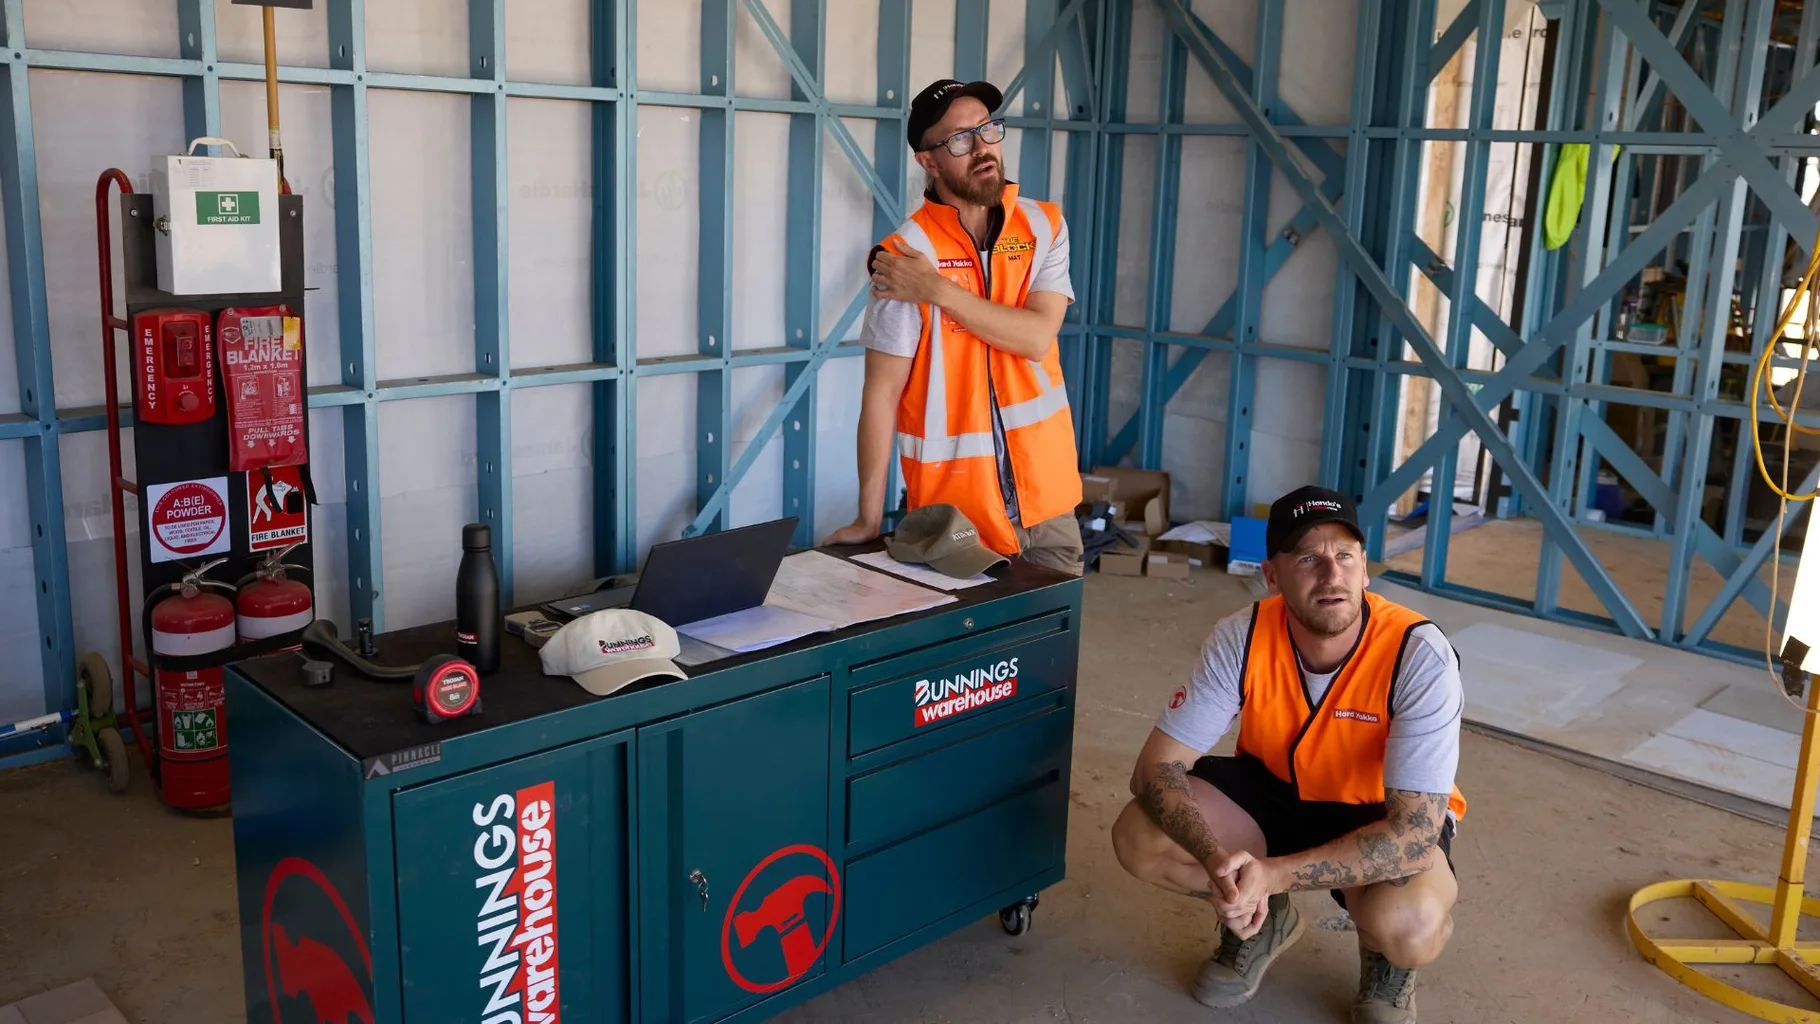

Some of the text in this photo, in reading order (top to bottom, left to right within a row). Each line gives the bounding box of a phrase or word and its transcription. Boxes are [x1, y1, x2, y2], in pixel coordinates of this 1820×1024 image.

[992, 241, 1035, 254] BLOCK
[244, 336, 281, 350] FIRE
[144, 329, 156, 409] EMERGENCY
[204, 325, 213, 404] EMERGENCY
[243, 429, 300, 440] DOWNWARDS
[272, 424, 294, 432] TABS
[173, 495, 204, 508] A:B(E)
[166, 505, 212, 520] POWDER
[251, 526, 305, 541] FIRE BLANKET
[599, 635, 651, 649] BUNNINGS
[442, 675, 465, 685] TROJAN
[915, 657, 1018, 707] BUNNINGS
[922, 681, 1012, 722] warehouse
[1355, 712, 1378, 722] Yakka
[391, 743, 440, 765] PINNACLE
[472, 794, 521, 1024] NNINGS
